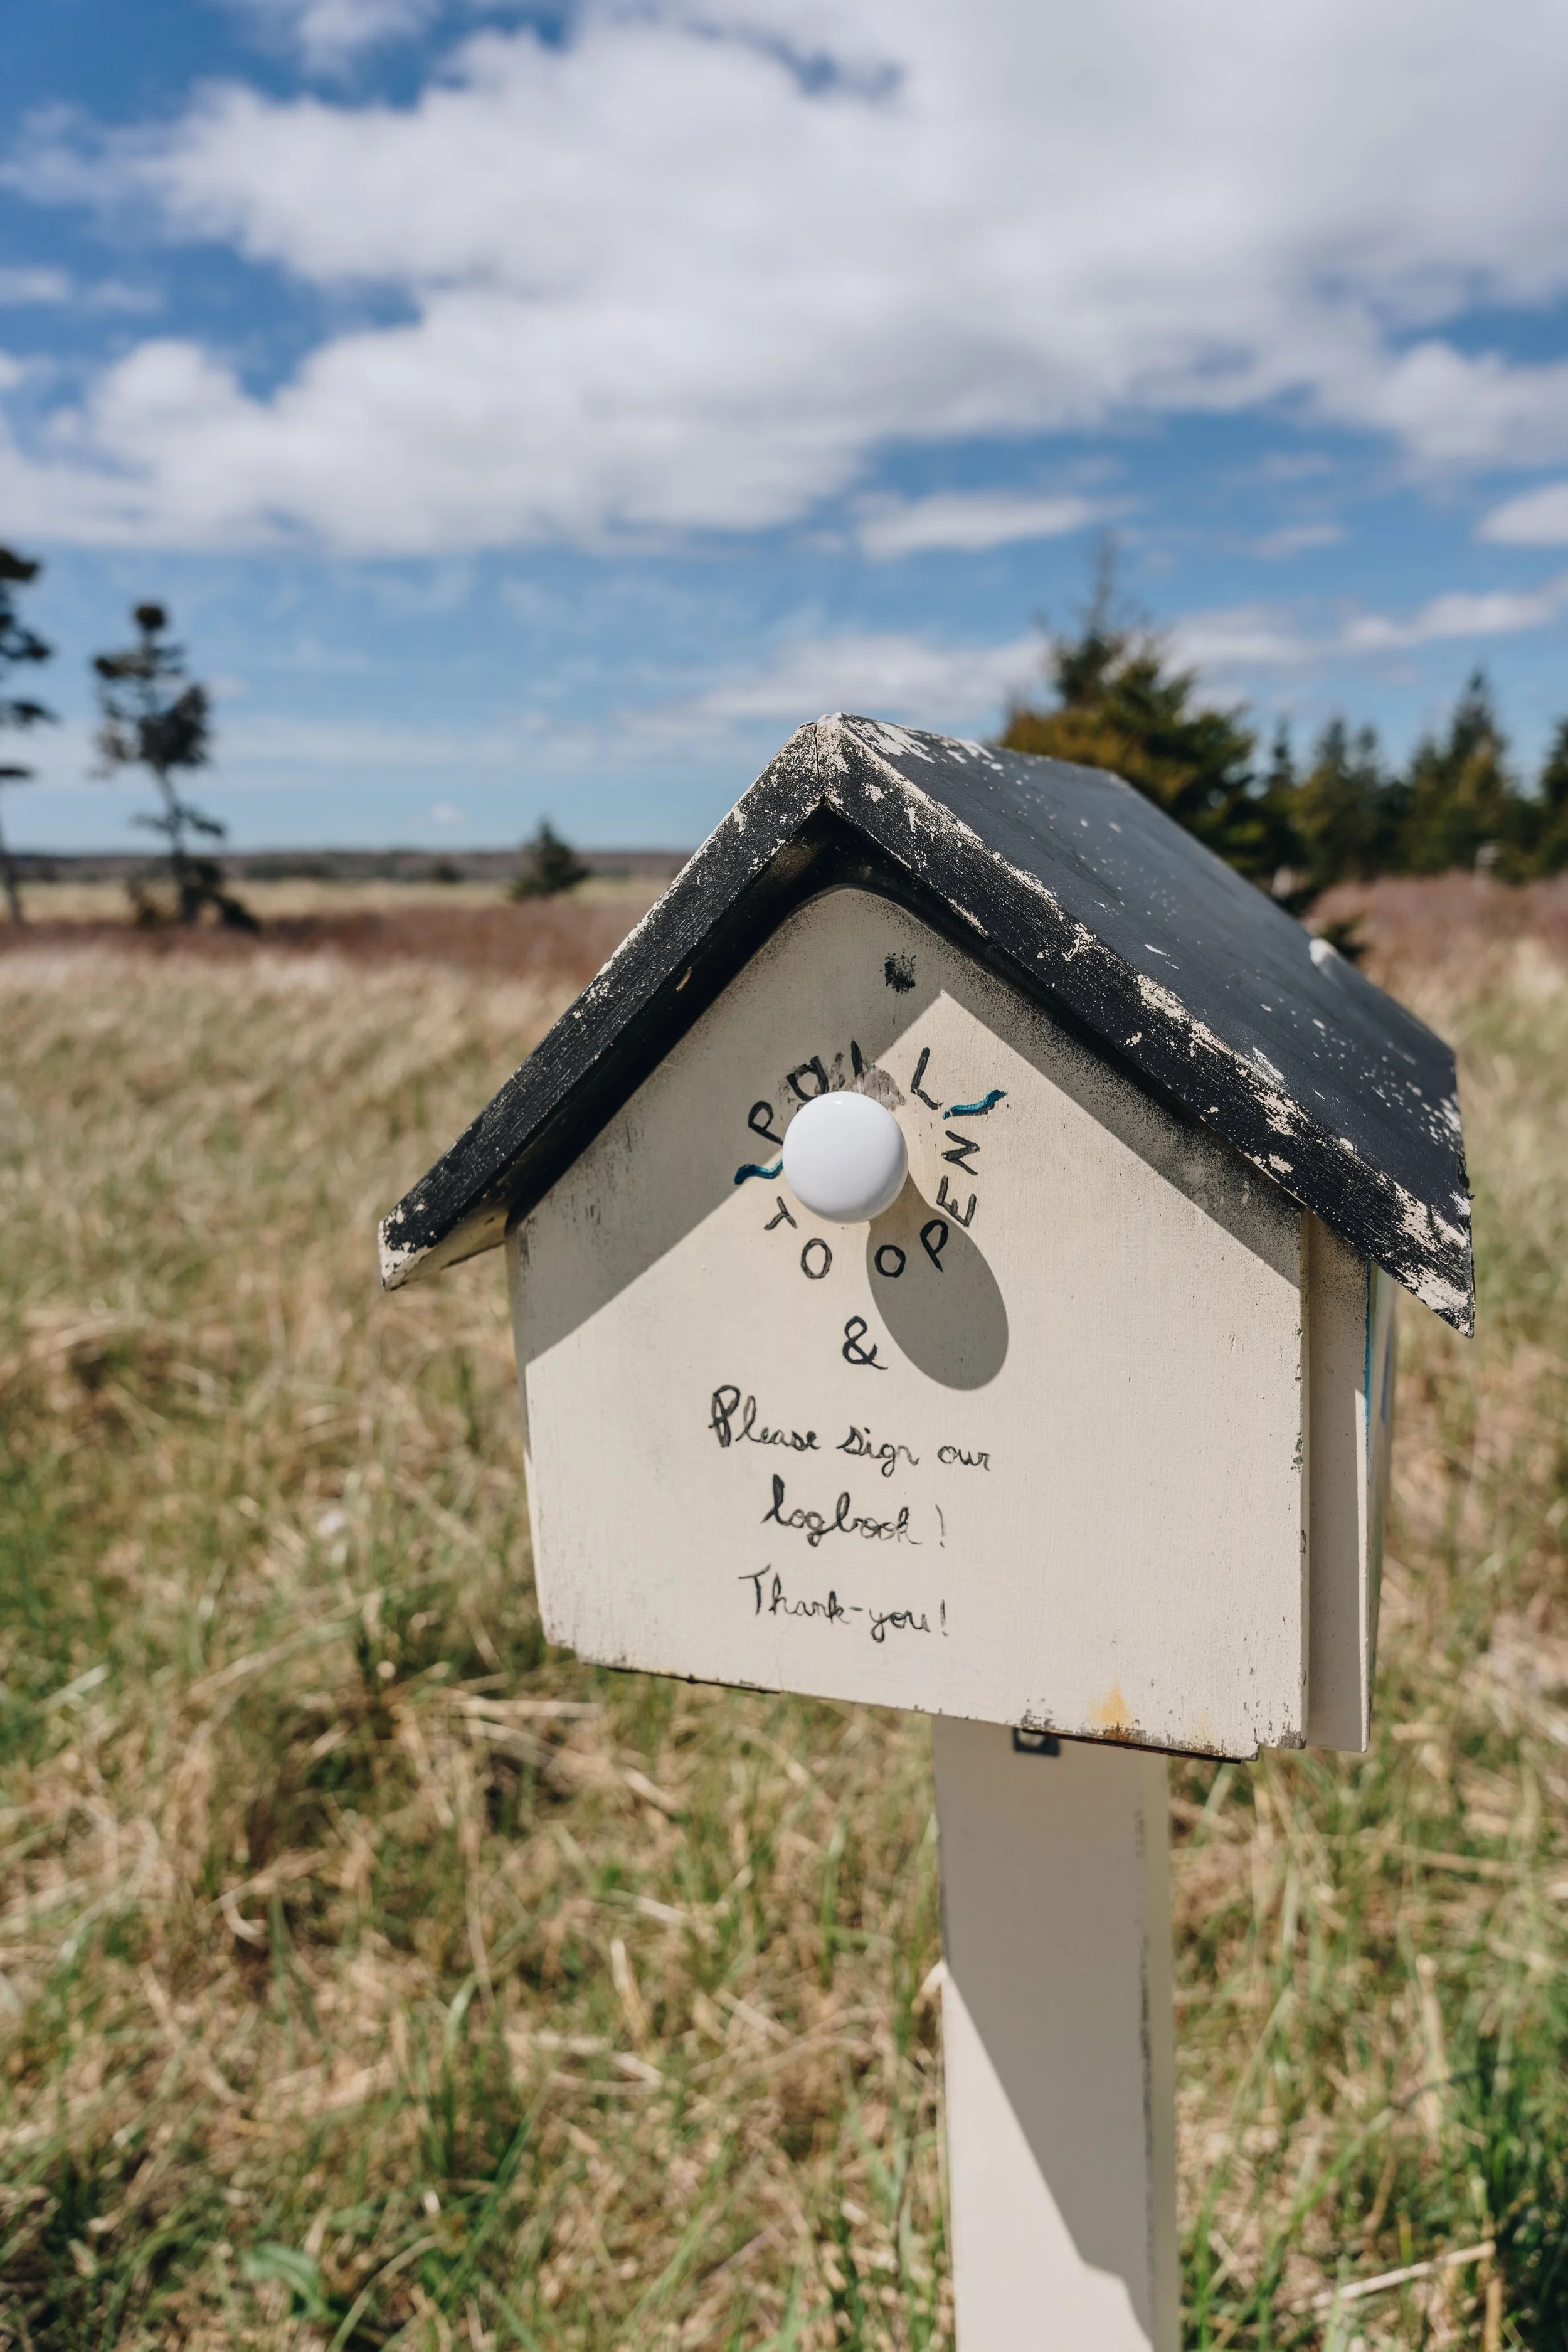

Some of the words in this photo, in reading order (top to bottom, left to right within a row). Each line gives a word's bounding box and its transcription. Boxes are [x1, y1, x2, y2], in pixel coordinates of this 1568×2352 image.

[764, 1196, 833, 1280] TO
[874, 1130, 981, 1279] OPEN
[842, 1315, 889, 1371] &
[708, 1384, 821, 1448] Please
[835, 1425, 920, 1478] sign
[936, 1445, 990, 1471] our
[738, 1564, 948, 1643] Thank-you!
